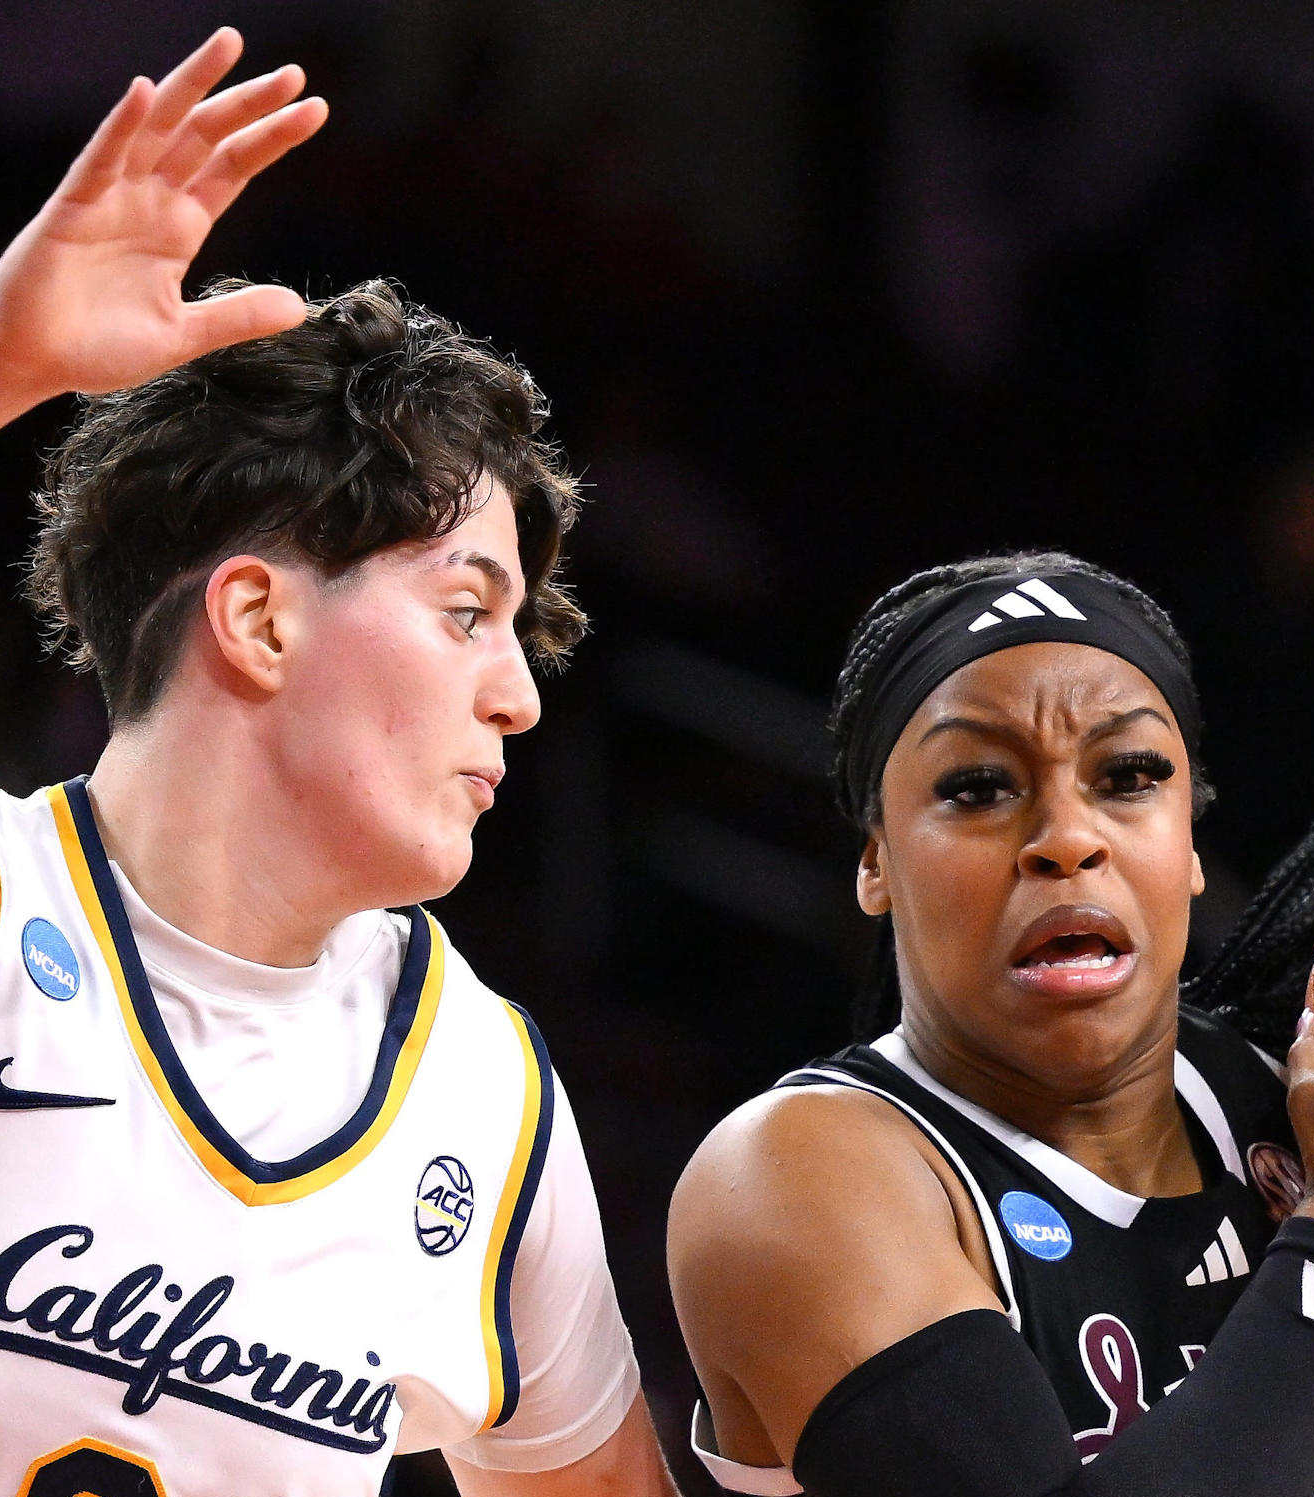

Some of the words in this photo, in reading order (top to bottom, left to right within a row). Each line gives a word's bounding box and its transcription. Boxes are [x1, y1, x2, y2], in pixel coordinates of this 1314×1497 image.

[29, 944, 76, 991] NCAA
[422, 1186, 474, 1222] ACC
[1013, 1223, 1070, 1243] NCAA
